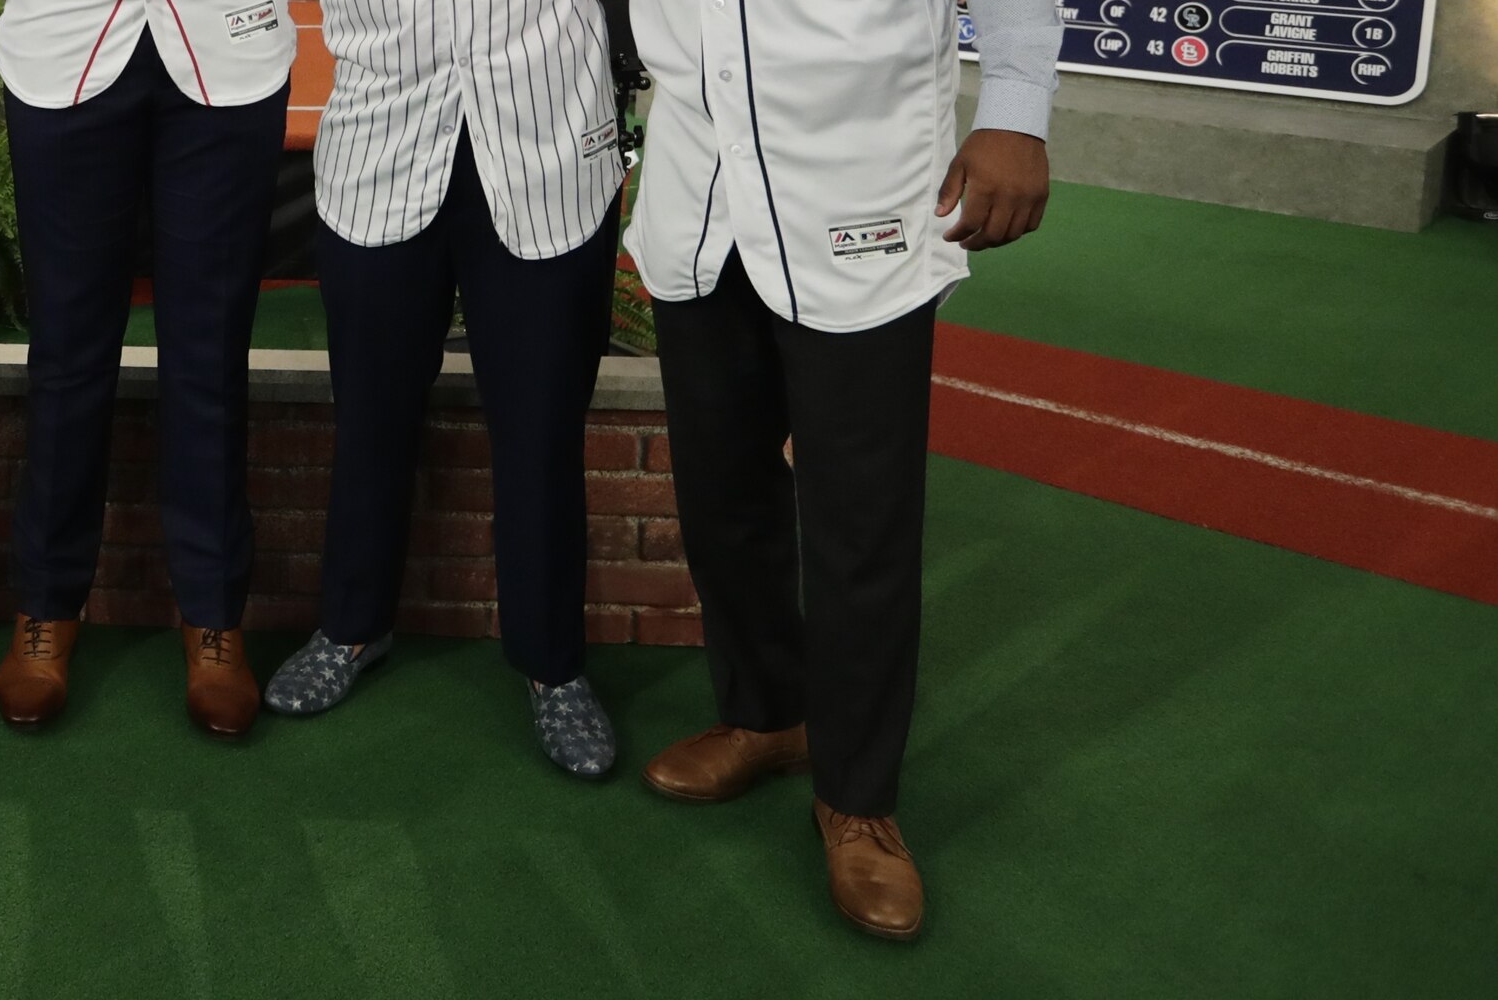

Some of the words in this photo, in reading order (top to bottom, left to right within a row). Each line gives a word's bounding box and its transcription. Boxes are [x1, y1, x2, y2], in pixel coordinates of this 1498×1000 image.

[1150, 7, 1166, 22] 42
[1270, 13, 1314, 28] GRANT
[1264, 25, 1317, 41] LAVIGNE
[1364, 27, 1382, 40] 1B
[1147, 40, 1164, 56] 43
[1266, 50, 1316, 64] GRIFFIN
[1261, 62, 1318, 77] ROBERTS
